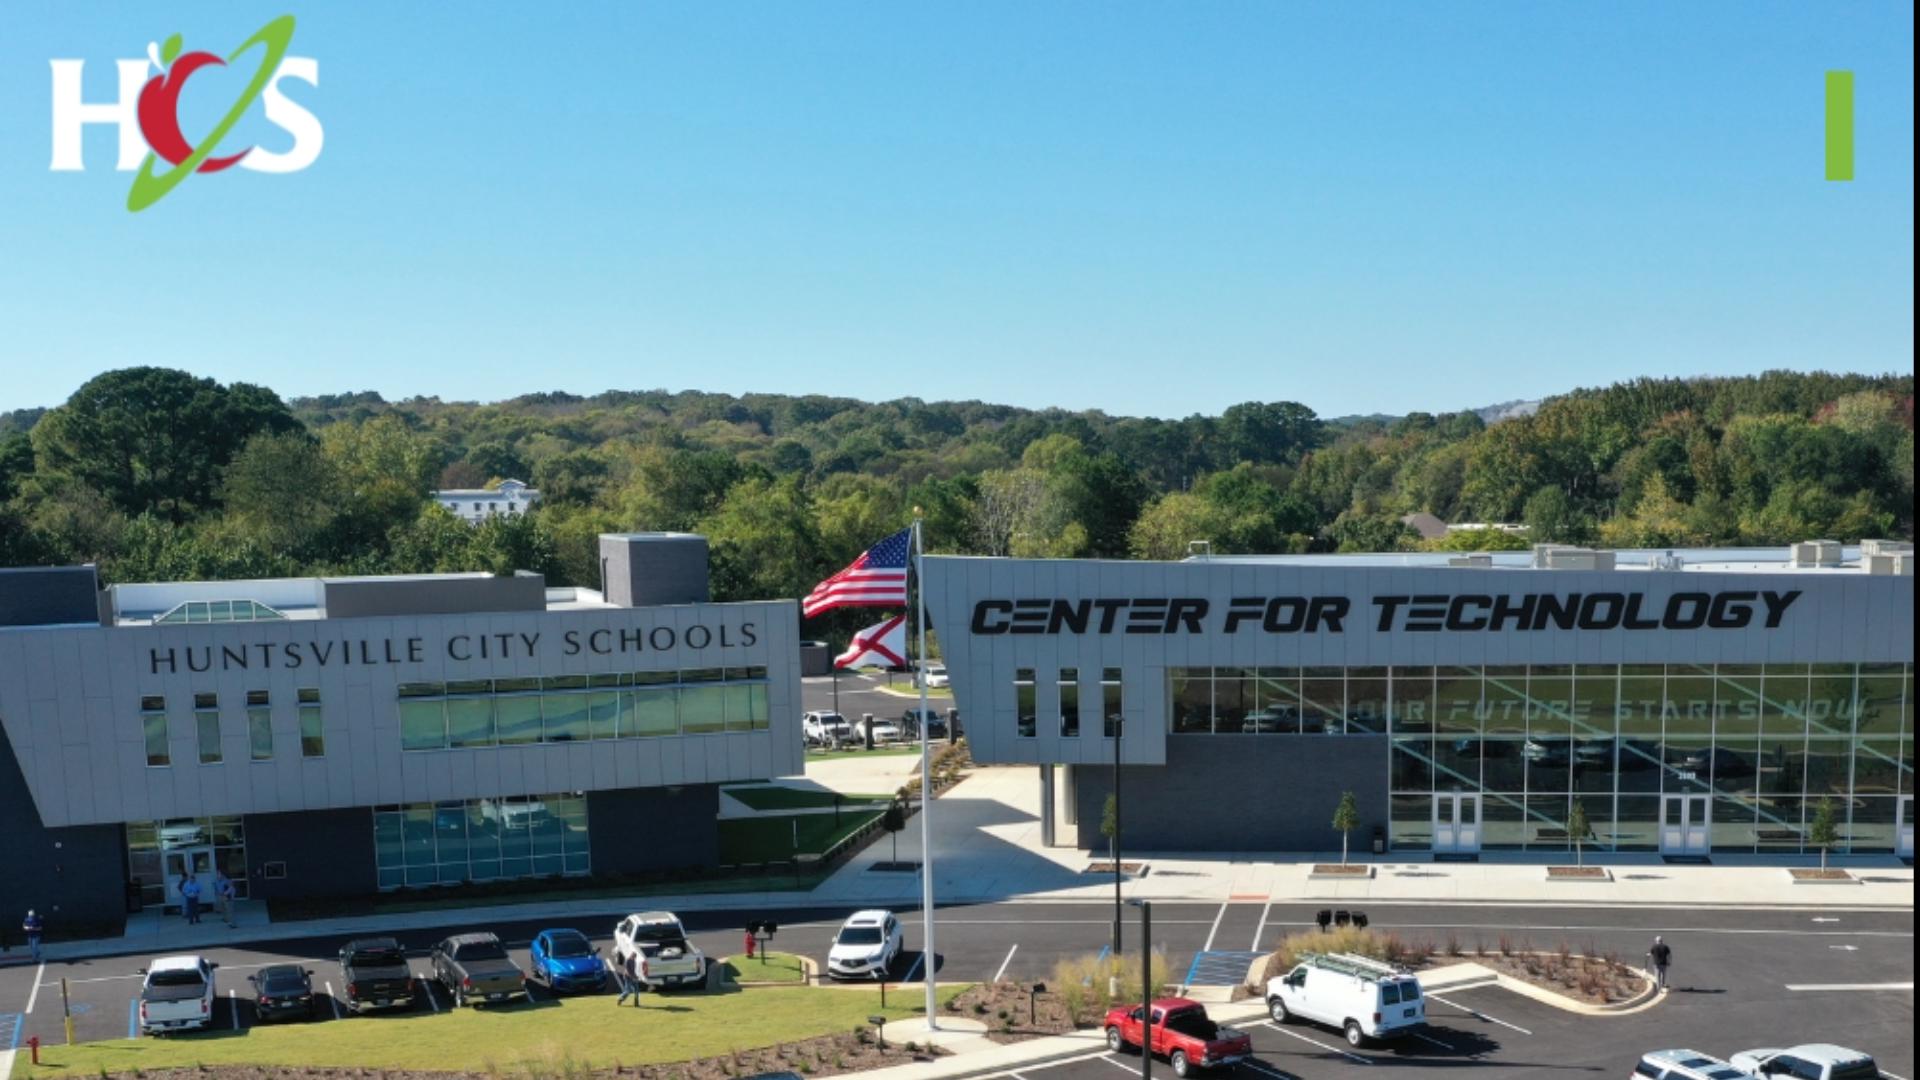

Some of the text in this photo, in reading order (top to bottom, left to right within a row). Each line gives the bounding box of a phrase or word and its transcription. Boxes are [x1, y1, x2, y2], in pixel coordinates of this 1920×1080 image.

[970, 590, 1803, 635] CENTER FOR TECHNOLOGY
[150, 622, 757, 675] HUNTSVILLE CITY SCHOOLS
[1449, 700, 1593, 721] FUTURE
[1615, 699, 1758, 721] STARTS
[1781, 698, 1868, 720] NOW
